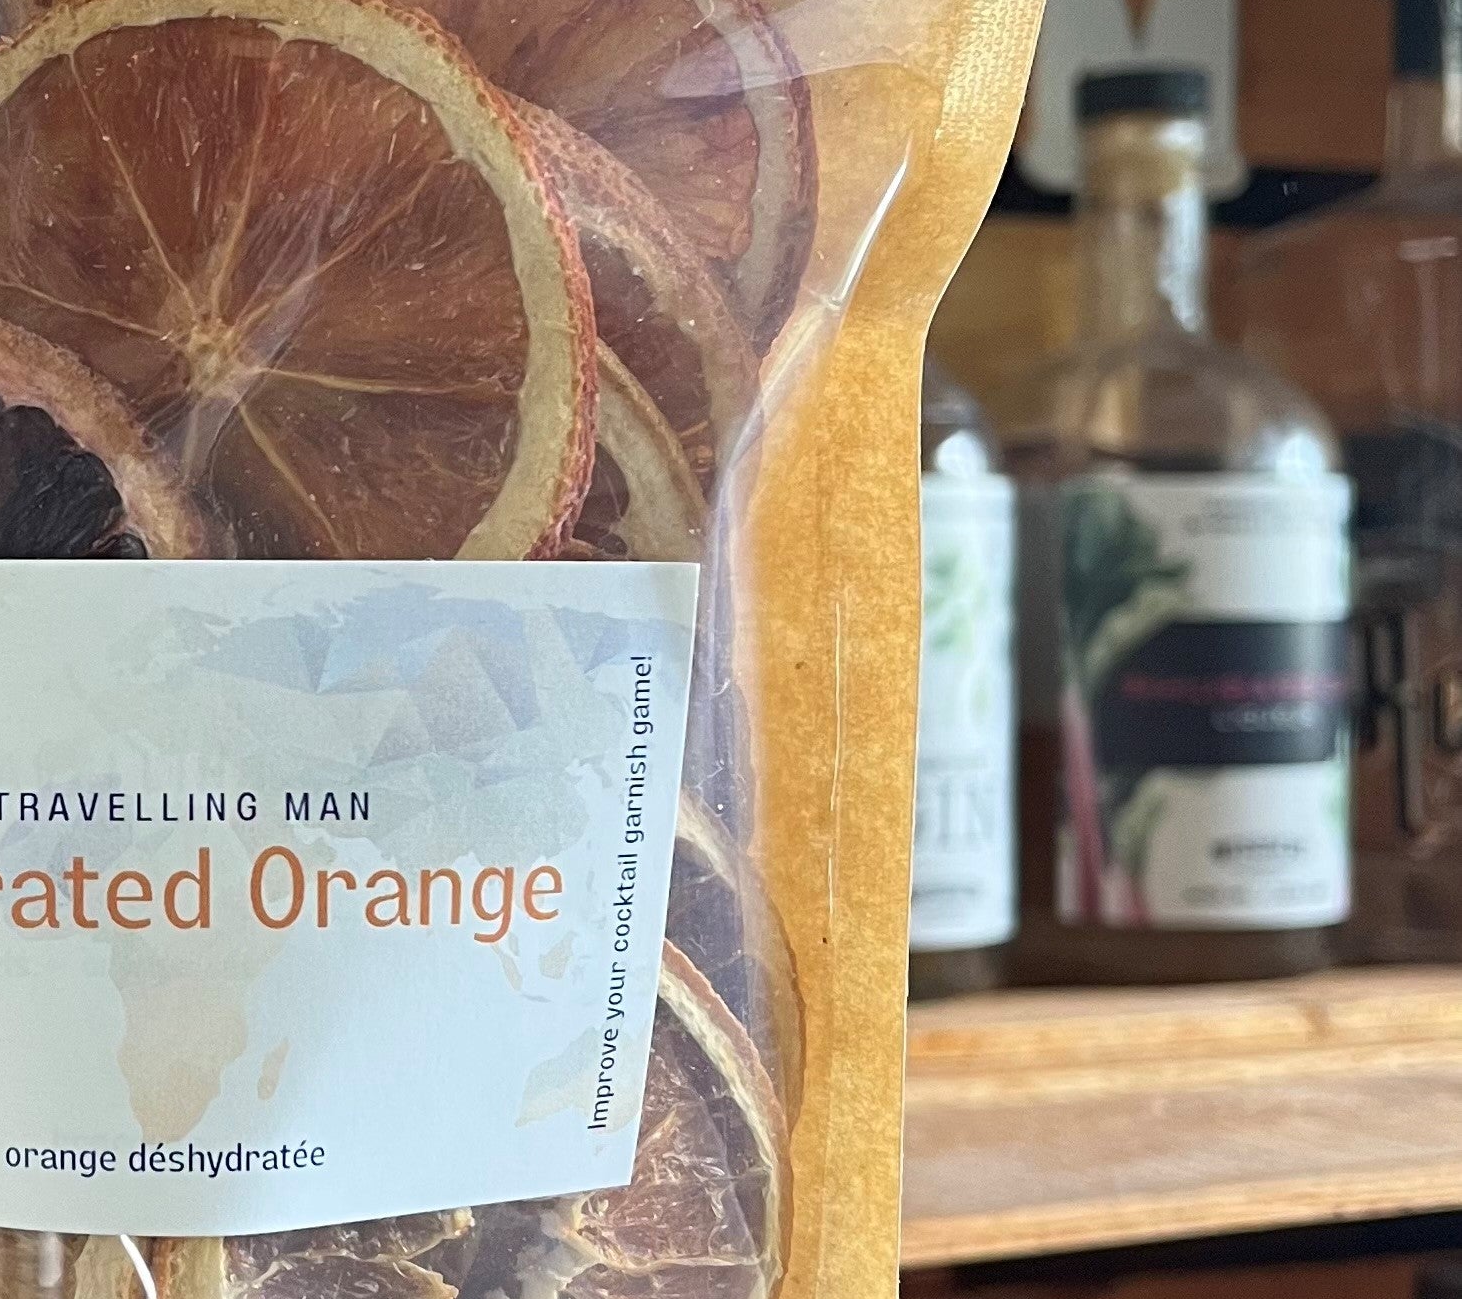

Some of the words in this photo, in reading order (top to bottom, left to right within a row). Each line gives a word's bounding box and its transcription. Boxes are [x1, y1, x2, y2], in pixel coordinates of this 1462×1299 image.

[630, 656, 654, 735] game!
[285, 791, 369, 822] MAN
[624, 745, 647, 844] garnish
[249, 845, 563, 943] Orange
[613, 853, 639, 952] cocktail
[606, 961, 627, 1020] your
[587, 1028, 620, 1130] Improve
[5, 1146, 117, 1178] orange
[128, 1140, 325, 1179] déshydratée
